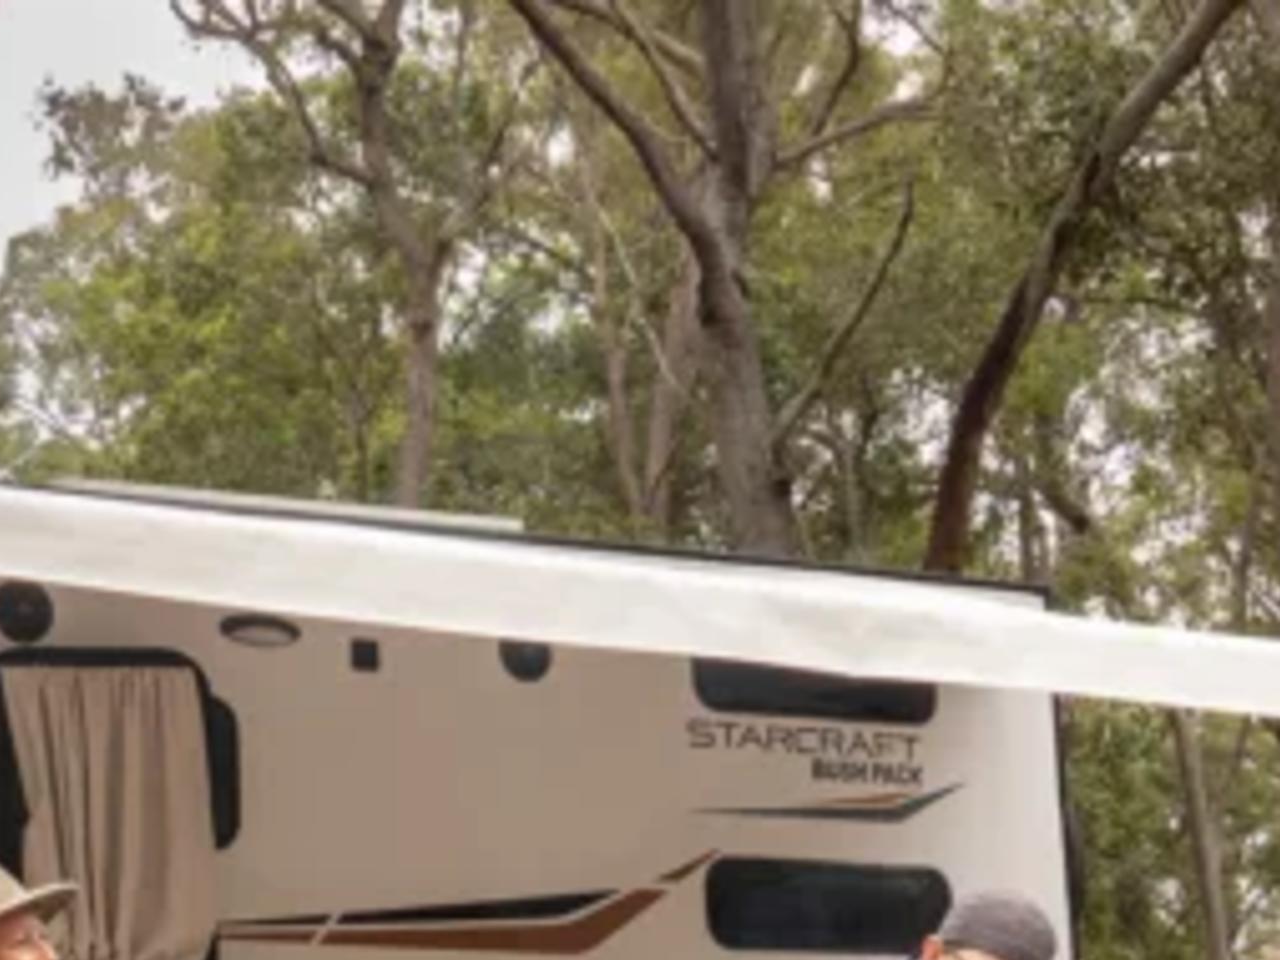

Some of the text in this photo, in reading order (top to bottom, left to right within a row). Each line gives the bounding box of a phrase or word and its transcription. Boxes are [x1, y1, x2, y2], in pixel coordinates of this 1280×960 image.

[686, 718, 922, 761] STARCRAFT
[811, 758, 924, 785] BUSH PACK
